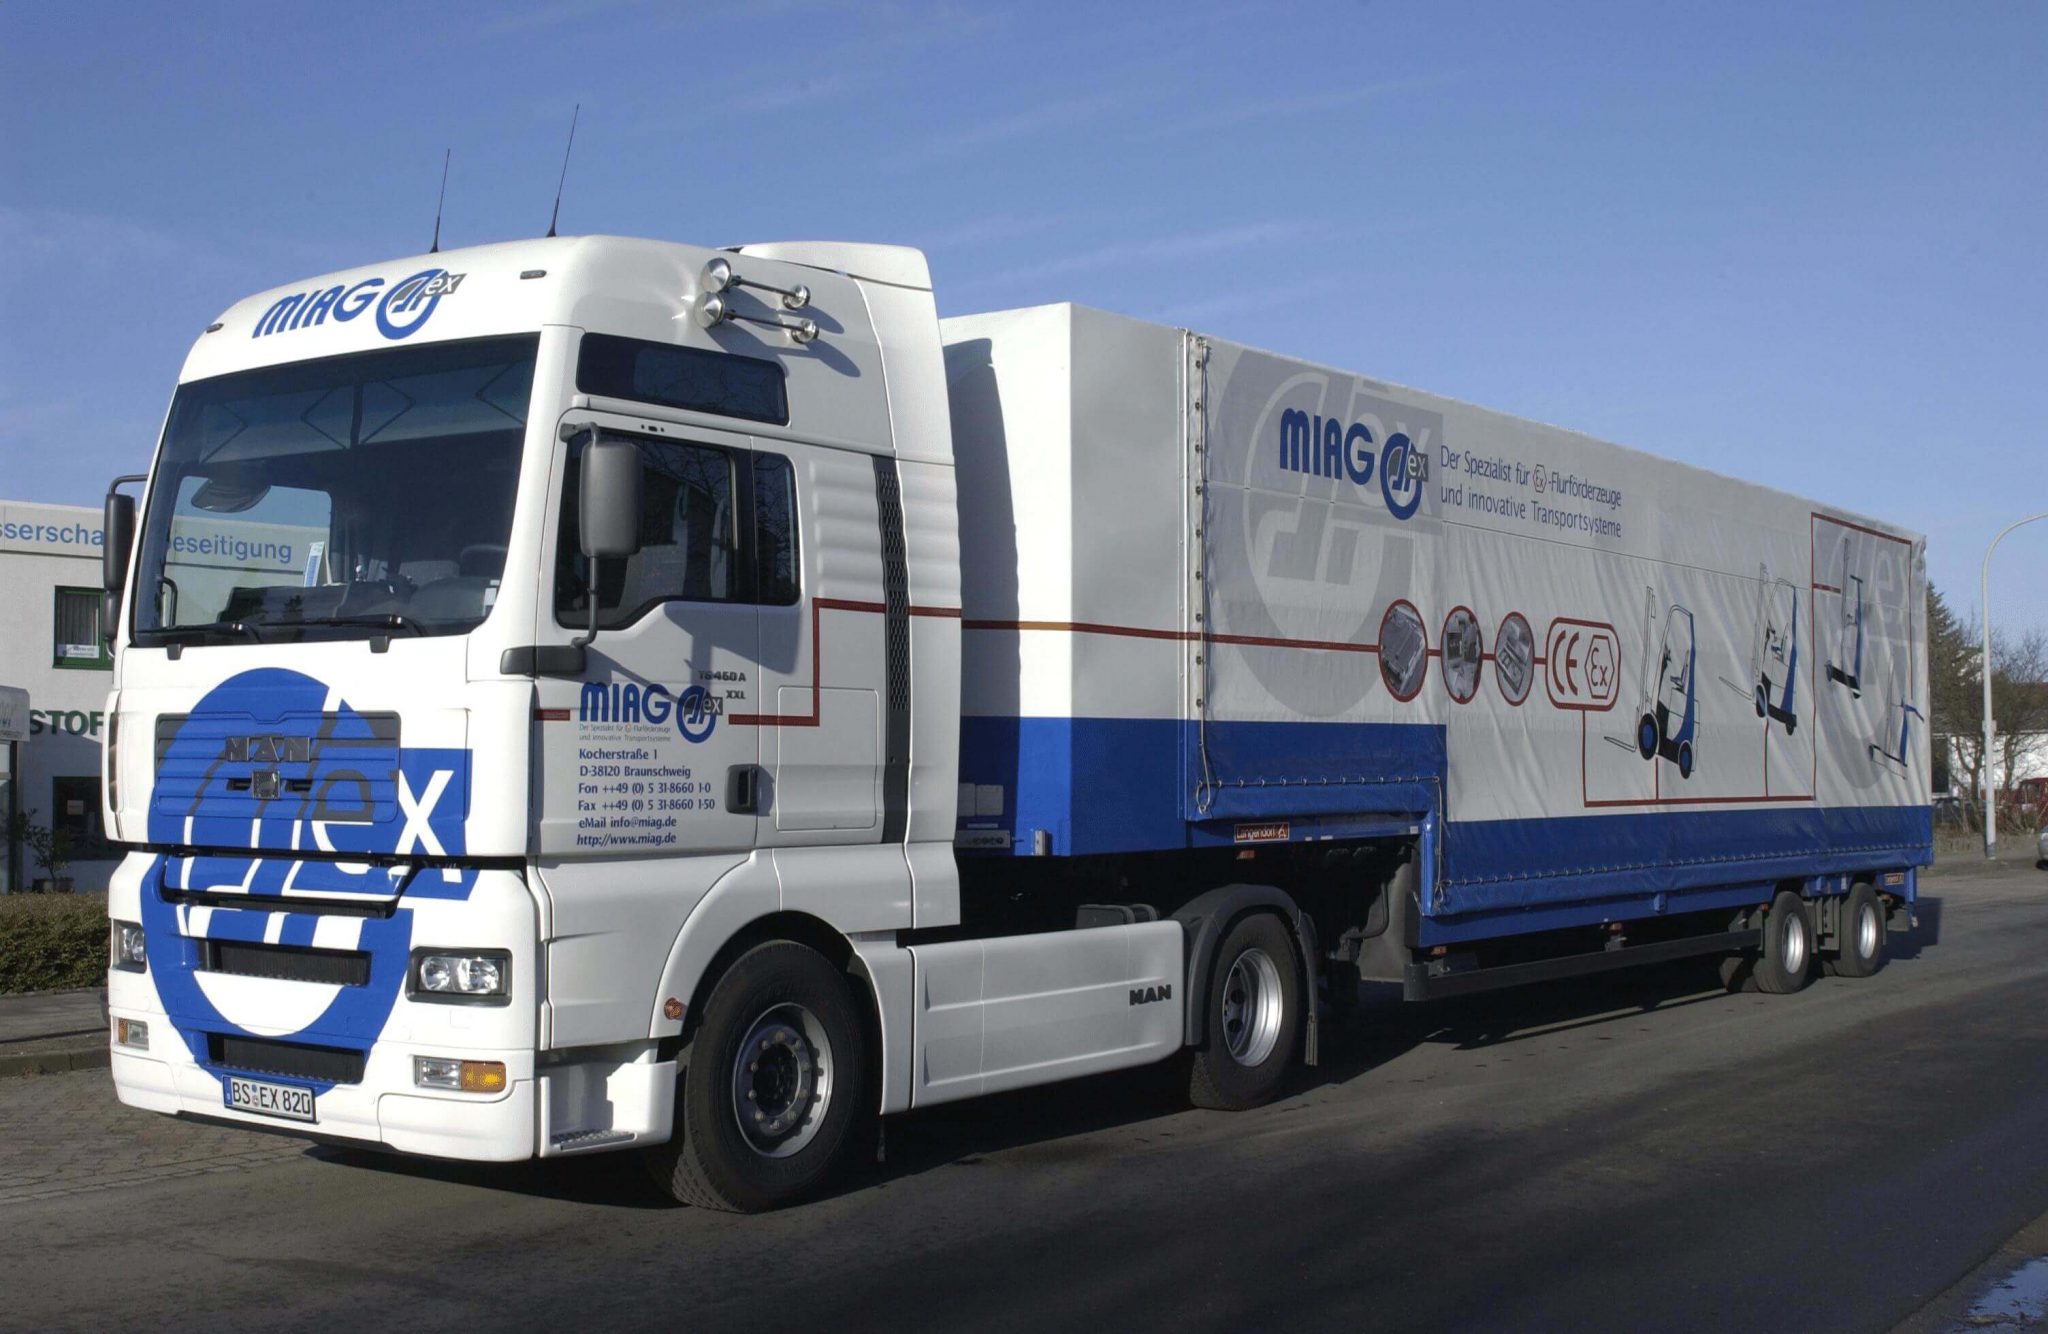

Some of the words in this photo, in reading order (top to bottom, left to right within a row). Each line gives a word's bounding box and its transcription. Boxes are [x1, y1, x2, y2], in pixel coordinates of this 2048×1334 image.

[252, 277, 385, 339] MIAG
[1279, 407, 1375, 486] MIAG
[1407, 453, 1427, 478] ex
[1440, 444, 1461, 470] Der
[1464, 450, 1511, 483] Spezialist
[1516, 462, 1530, 486] für
[1440, 484, 1463, 506] und
[1468, 487, 1526, 520] innovative
[1531, 500, 1622, 539] Transportsysteme
[0, 522, 104, 545] serscha
[167, 534, 292, 564] eseitigung
[579, 682, 671, 725] MIAG
[703, 697, 722, 713] ex
[726, 689, 746, 700] XXL
[225, 736, 310, 761] MAN
[579, 748, 649, 760] Kocherstraße
[580, 765, 620, 777] D-38120
[624, 765, 691, 779] Braunschweig
[578, 783, 598, 794] Fon
[602, 782, 628, 794] ++49
[632, 782, 644, 795] (0)
[648, 782, 654, 793] 5
[657, 782, 694, 794] 31-8660
[578, 800, 597, 811] Fax
[601, 799, 628, 811] ++49
[631, 799, 644, 812] (0)
[648, 799, 654, 811] 5
[657, 798, 694, 811] 31-8660
[578, 817, 607, 829] eMail
[610, 815, 677, 830] info@miag.de
[576, 832, 677, 847] http://www.miag.de
[1129, 984, 1172, 1006] MAN
[232, 1082, 251, 1105] BS
[260, 1086, 280, 1110] EX
[282, 1090, 311, 1114] 820
